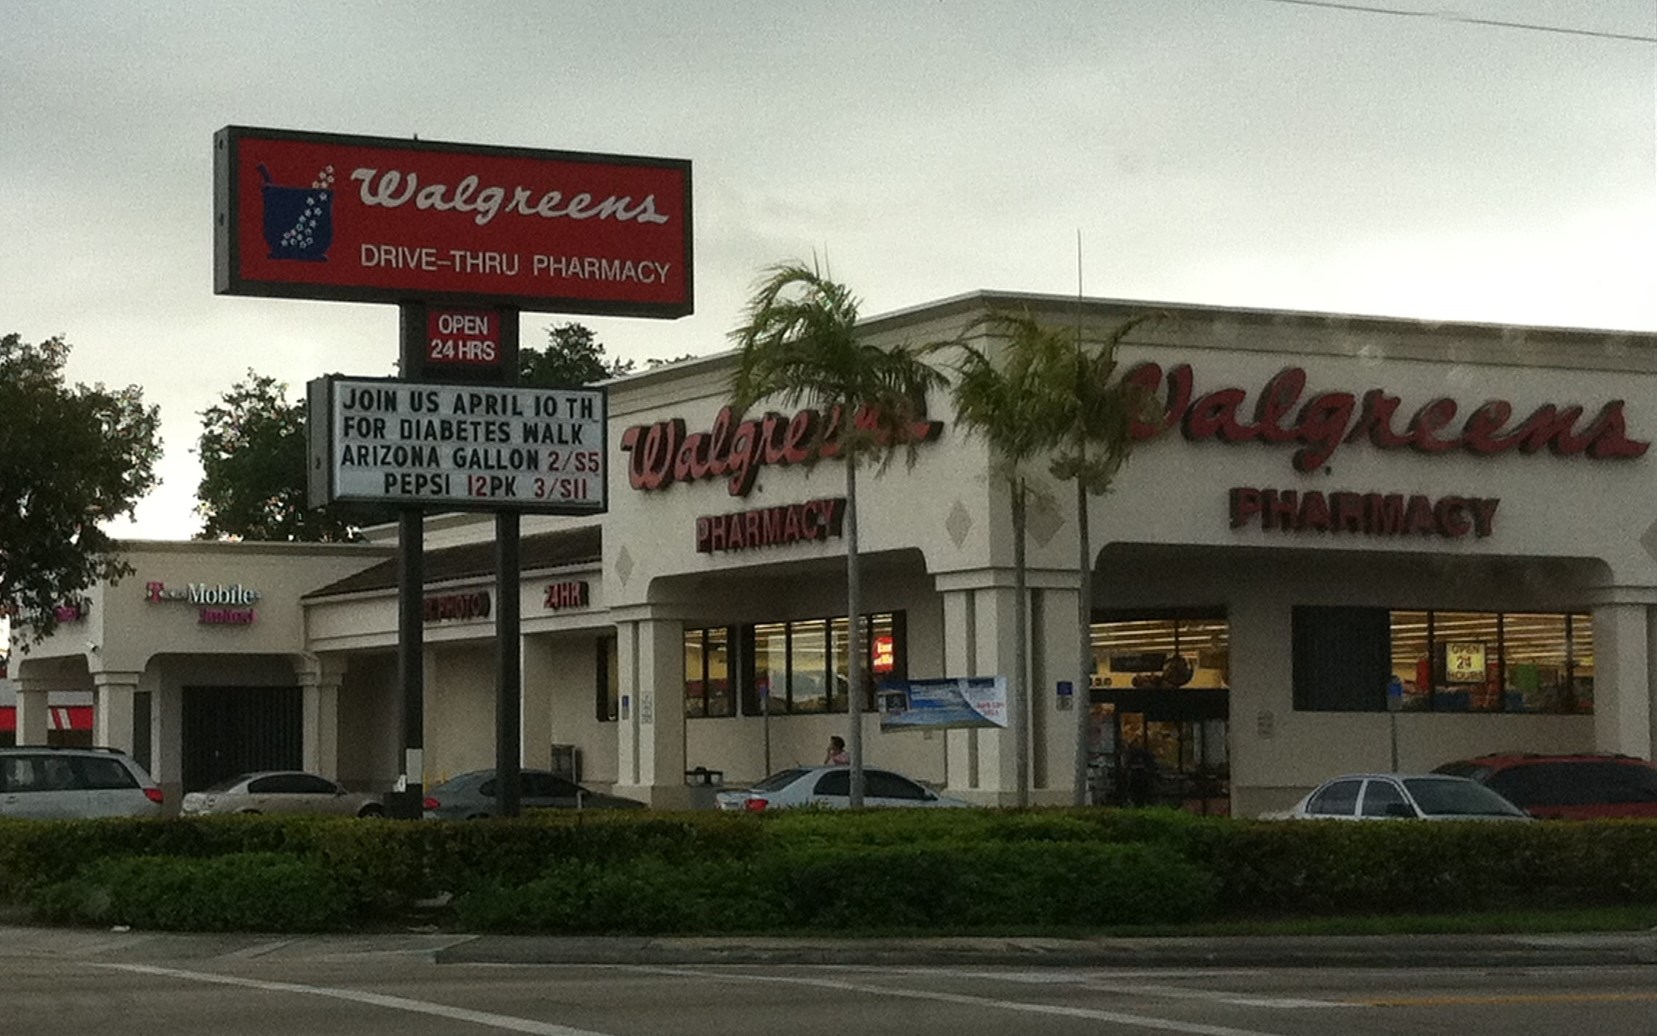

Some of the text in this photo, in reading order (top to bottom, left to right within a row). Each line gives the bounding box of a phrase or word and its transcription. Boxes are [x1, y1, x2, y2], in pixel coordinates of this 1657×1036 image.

[350, 167, 669, 226] Walgreens
[360, 244, 671, 285] DRIVE-THRU PHARMACY
[438, 314, 488, 336] OPEN
[430, 338, 496, 362] 24 HRS
[342, 388, 397, 413] JOIN
[410, 391, 440, 413] US
[453, 393, 523, 417] APRIL
[565, 397, 593, 419] TH
[342, 416, 583, 445] FOR DIABETES WALK
[341, 444, 440, 468] ARIZONA
[453, 448, 539, 471] GALLON
[621, 405, 943, 496] Walgree
[384, 472, 450, 496] PEPSI
[468, 475, 517, 498] 12PK
[696, 499, 844, 553] PHARMACY
[1229, 487, 1501, 538] PHARMACY
[1456, 655, 1472, 669] 24
